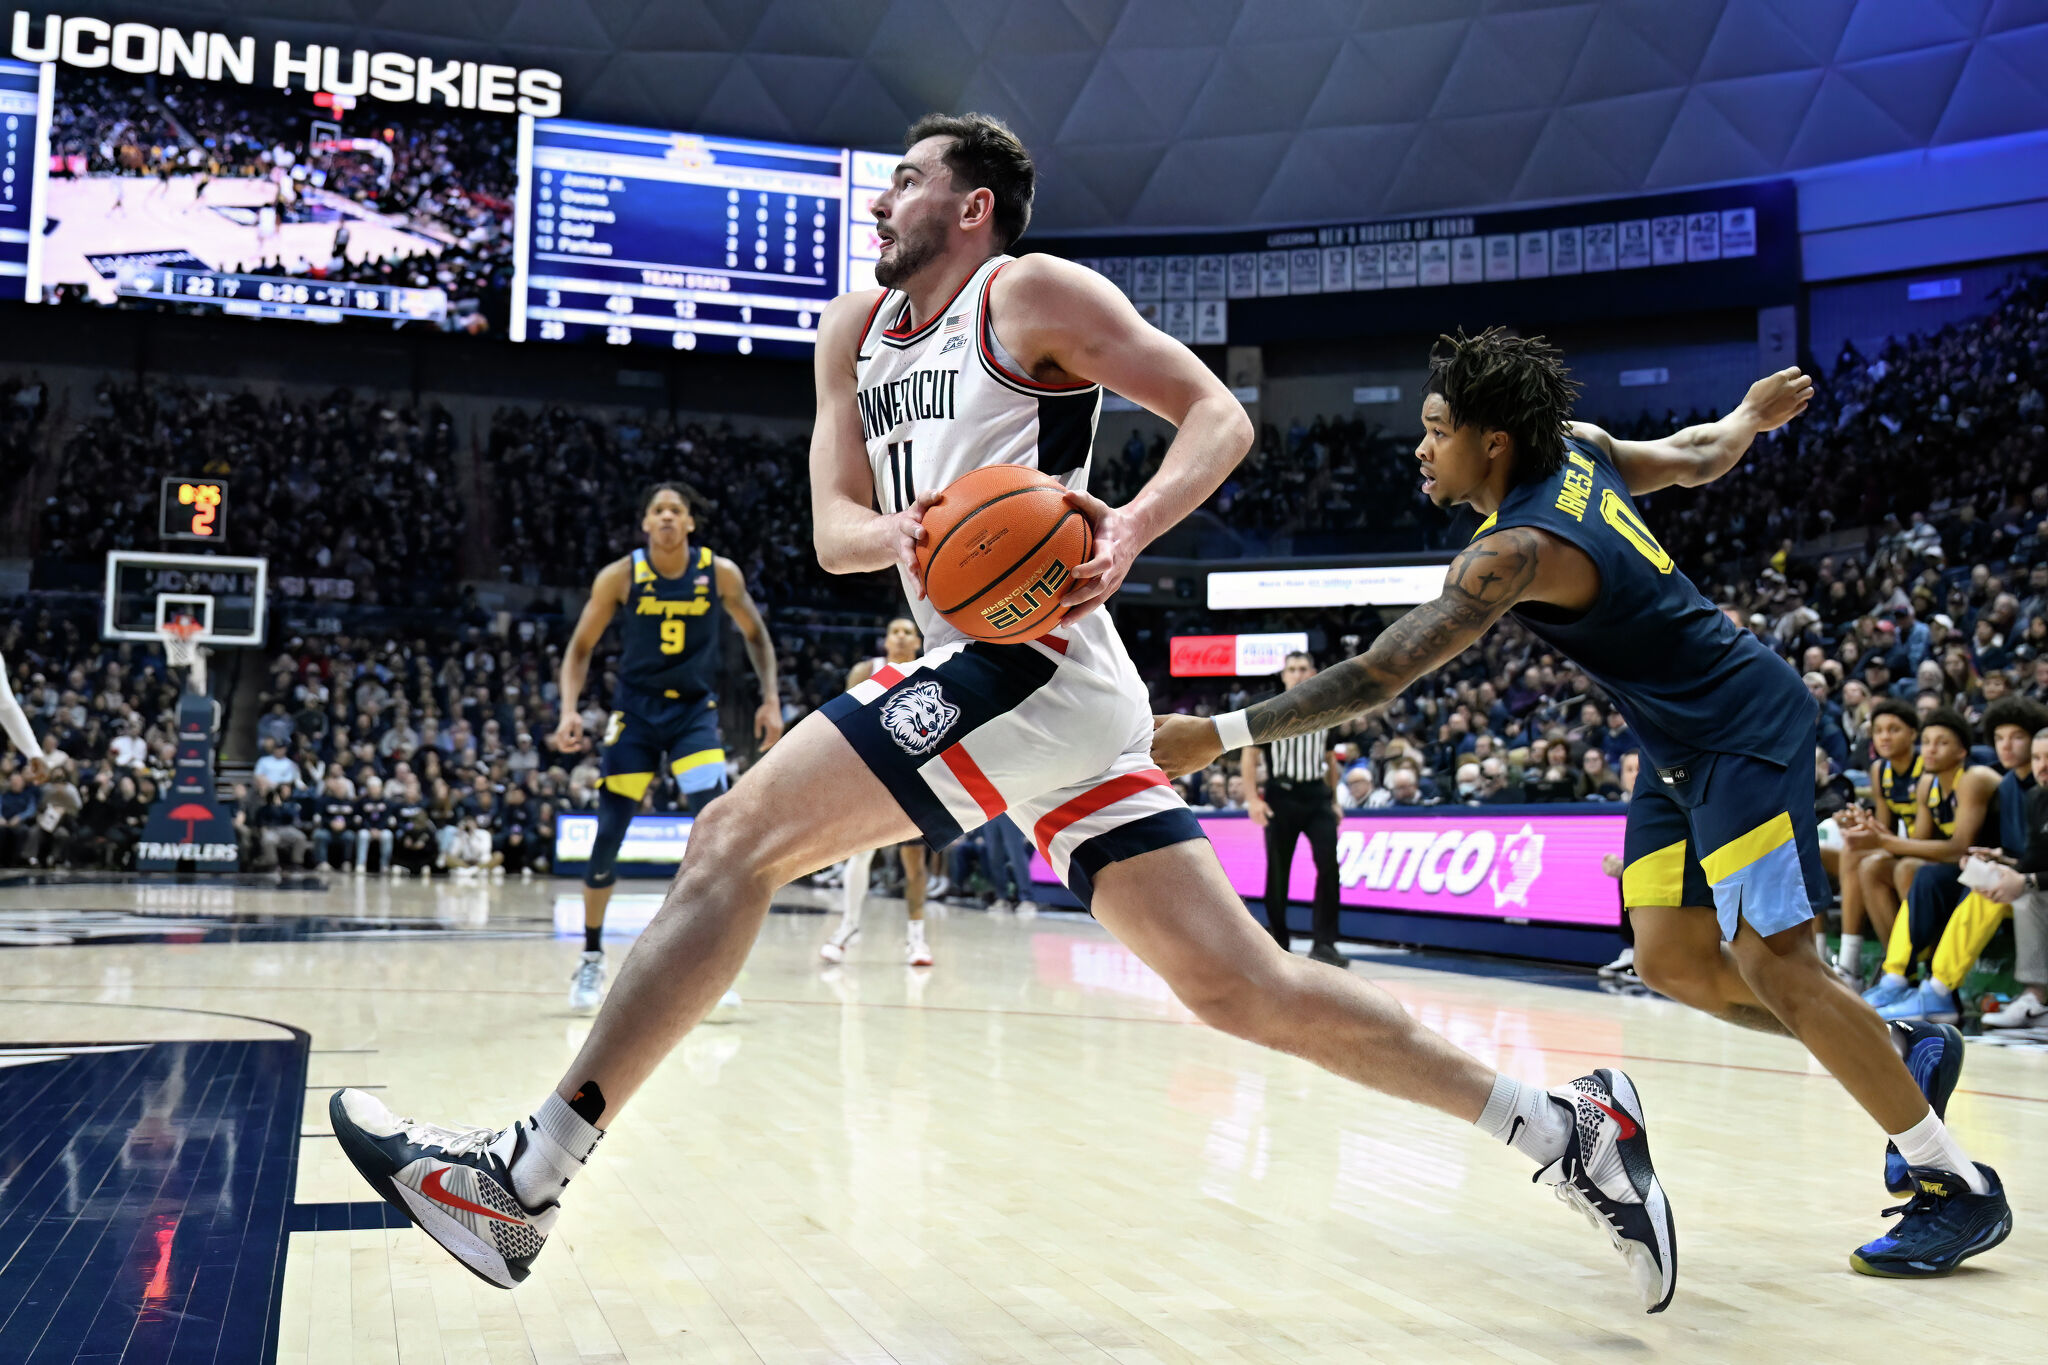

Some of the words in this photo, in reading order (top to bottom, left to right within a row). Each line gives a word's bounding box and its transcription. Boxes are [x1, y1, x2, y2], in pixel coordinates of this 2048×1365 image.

[11, 10, 256, 85] UCONN
[272, 40, 562, 118] HUSKIES
[641, 269, 684, 287] TEAM
[685, 273, 731, 292] STATS
[1205, 303, 1217, 318] 4
[887, 439, 917, 514] 11
[1555, 469, 1594, 523] JAMES
[192, 503, 216, 536] 2
[1600, 488, 1675, 575] 0
[984, 558, 1071, 631] ELITE
[660, 619, 686, 656] 9
[137, 841, 239, 863] TRAVELERS
[1336, 829, 1497, 897] DATTCO
